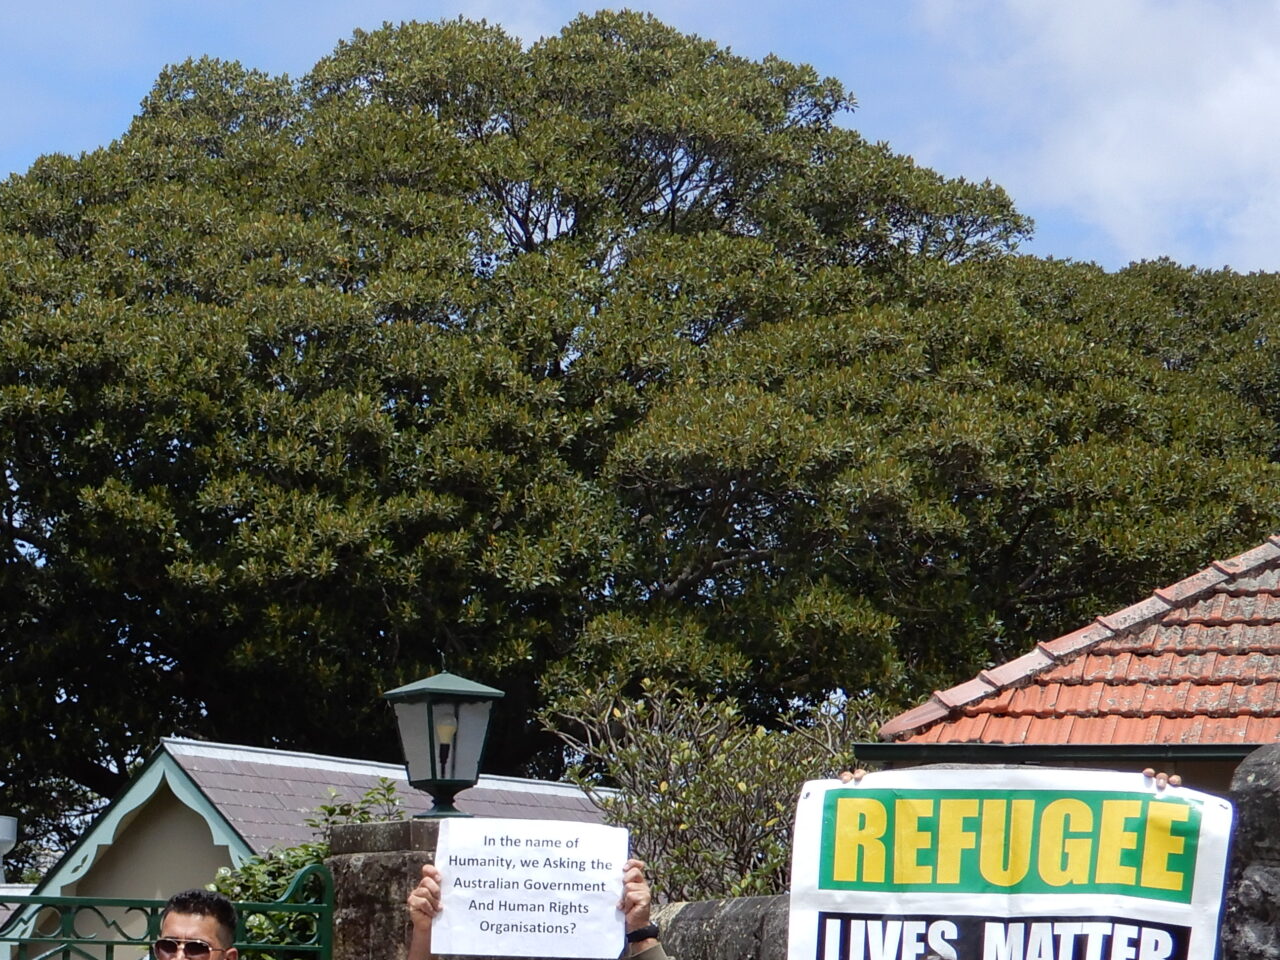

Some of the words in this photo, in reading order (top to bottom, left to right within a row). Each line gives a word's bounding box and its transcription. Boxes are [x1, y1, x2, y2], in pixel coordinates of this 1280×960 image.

[484, 835, 496, 846] In
[500, 836, 521, 847] the
[525, 838, 562, 848] name
[566, 837, 579, 849] of
[833, 798, 1189, 890] REFUGEE
[449, 855, 516, 869] Humanity,
[521, 859, 539, 868] we
[543, 857, 586, 871] Asking
[591, 859, 613, 870] the
[454, 877, 520, 890] Australian
[524, 879, 607, 892] Government
[469, 899, 494, 911] And
[499, 901, 545, 912] Human
[550, 901, 590, 915] Rights
[480, 920, 577, 934] Organisations?
